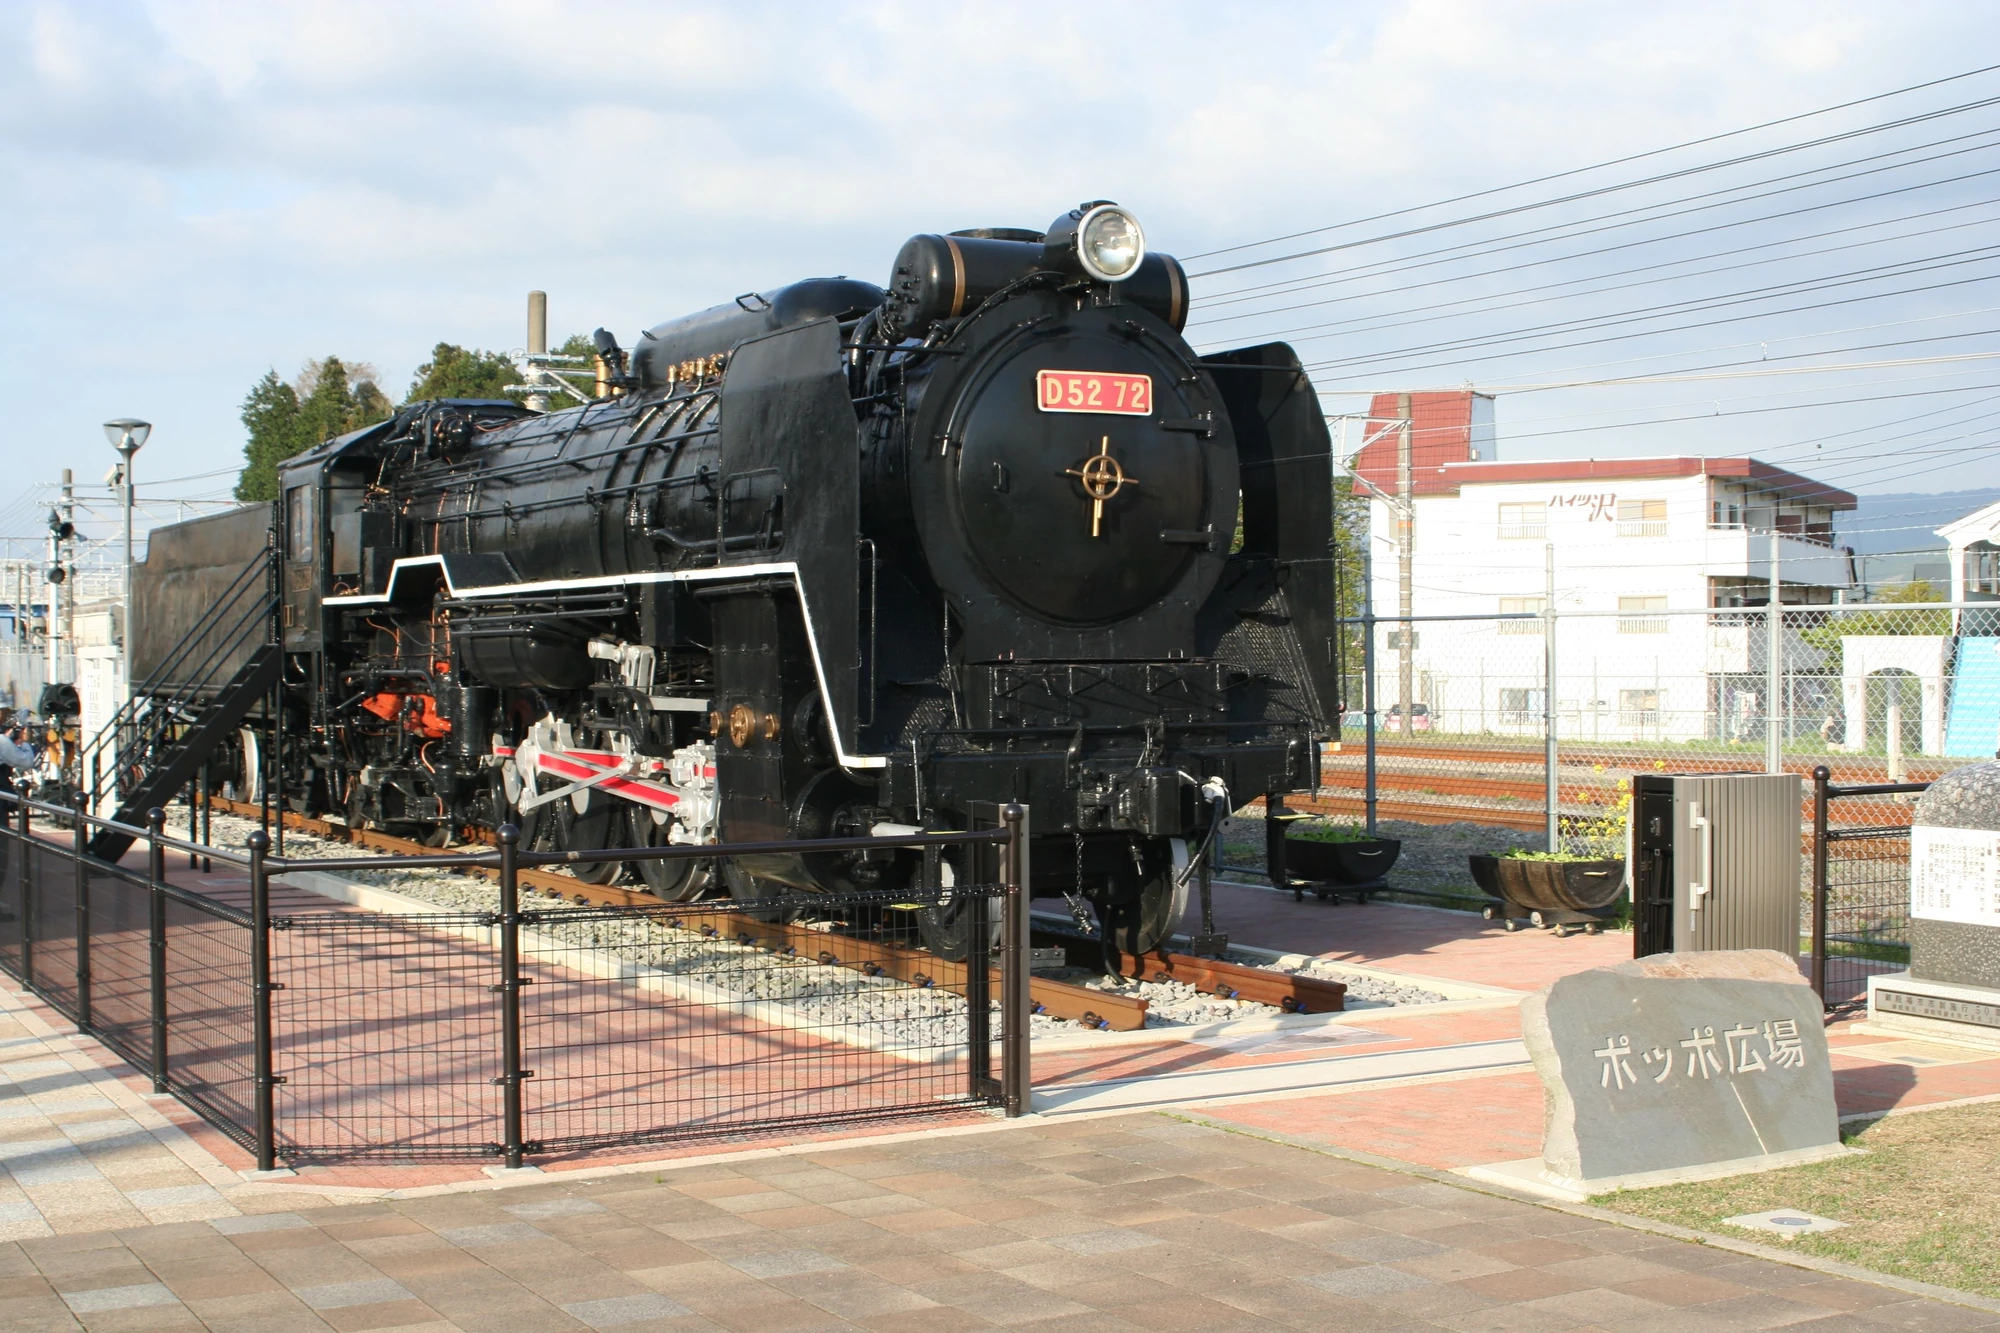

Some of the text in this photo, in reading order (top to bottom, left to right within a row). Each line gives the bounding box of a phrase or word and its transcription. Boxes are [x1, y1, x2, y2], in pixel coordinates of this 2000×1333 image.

[1046, 377, 1146, 409] D52 72
[1549, 492, 1617, 522] ハイツ沢
[1594, 1018, 1805, 1090] ポッポ広場
